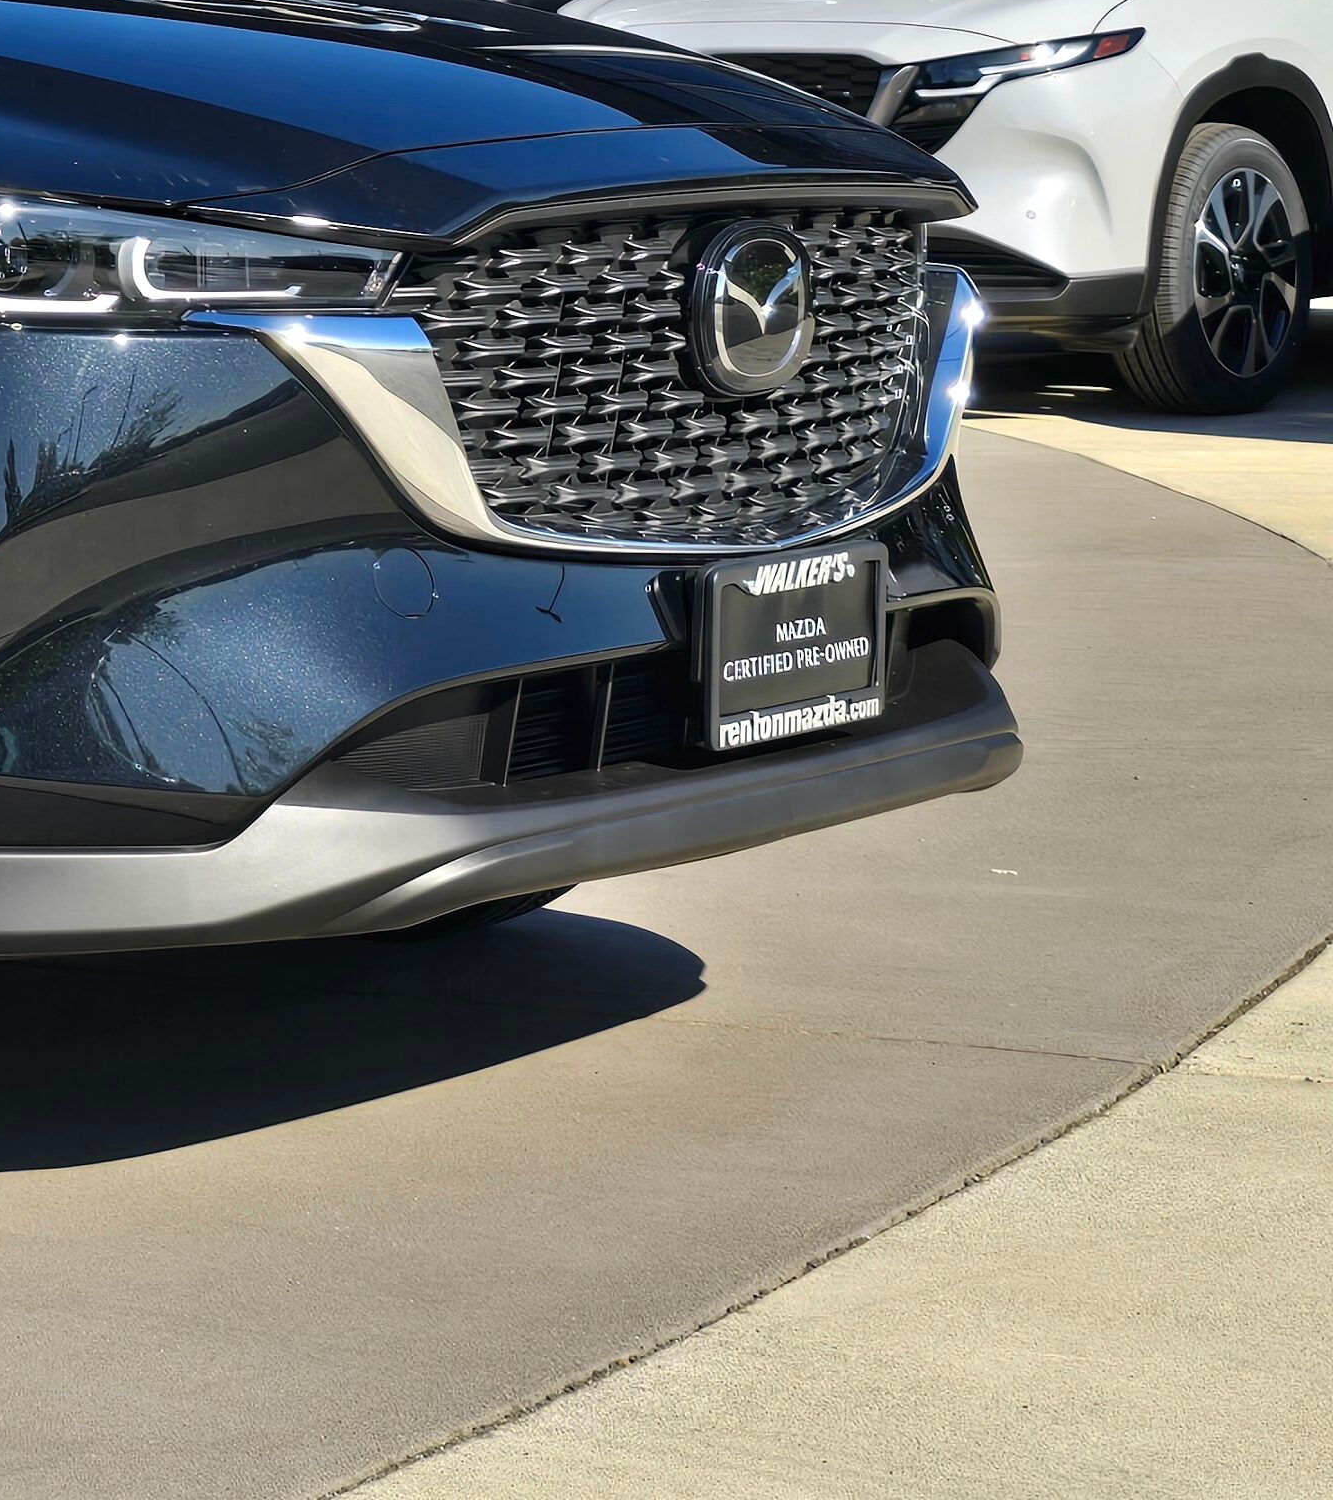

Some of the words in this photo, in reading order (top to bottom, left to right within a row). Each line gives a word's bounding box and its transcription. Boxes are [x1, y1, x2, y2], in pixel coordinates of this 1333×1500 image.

[744, 551, 855, 597] WALKER'S
[775, 616, 827, 643] MAZDA
[723, 651, 794, 683] CERTIFIED
[796, 636, 870, 670] PRE-OWNED
[719, 694, 881, 748] rentonmazda.com
